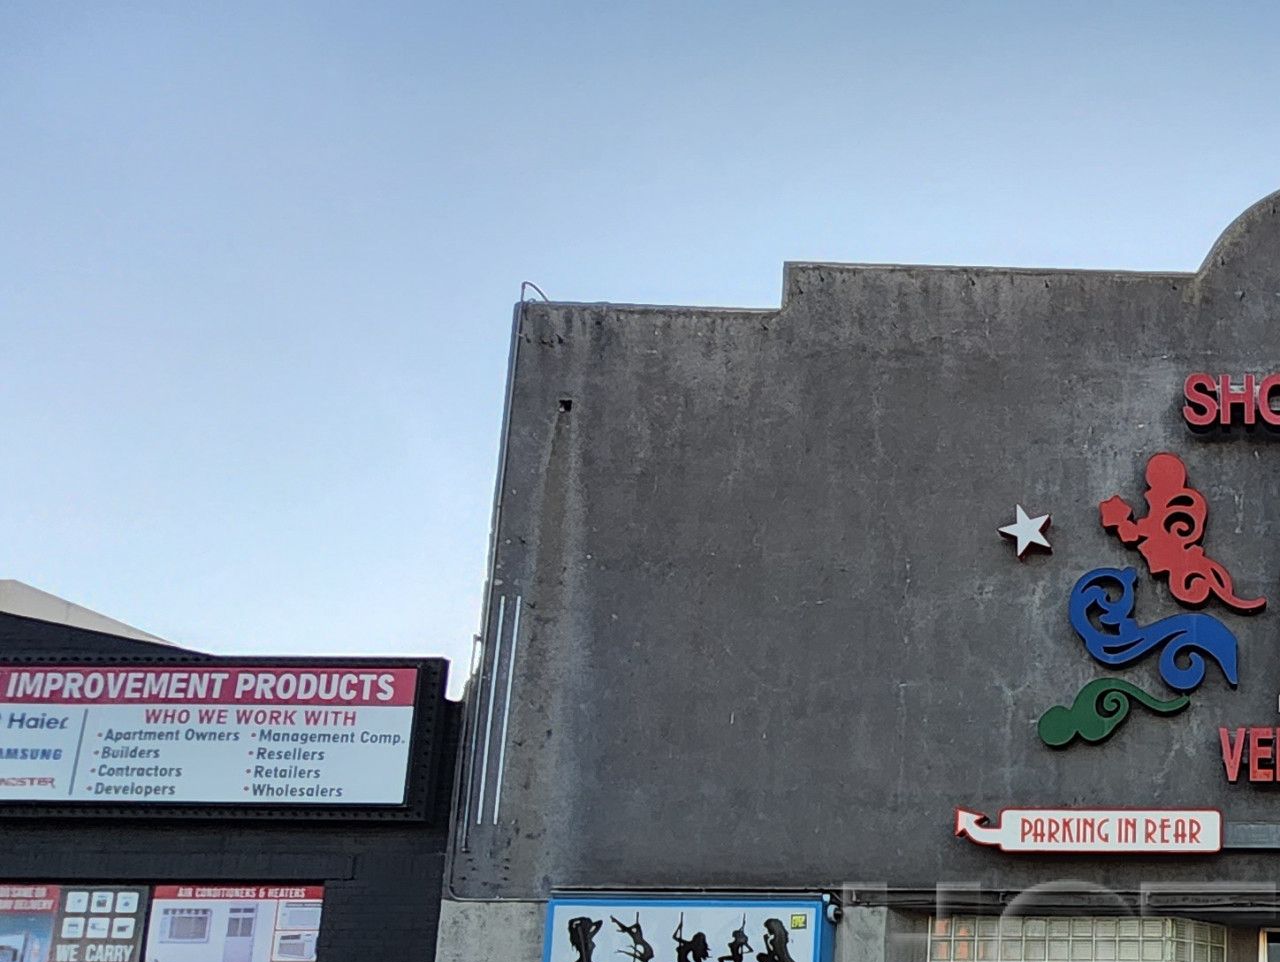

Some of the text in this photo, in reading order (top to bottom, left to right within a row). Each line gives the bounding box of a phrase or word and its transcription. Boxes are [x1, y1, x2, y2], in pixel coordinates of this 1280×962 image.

[6, 671, 396, 701] IMPROVEMENT PRODUCTS
[7, 711, 70, 730] Haier
[145, 708, 357, 727] WHO WE WORK WITH
[104, 728, 241, 742] Apartment Owners
[259, 729, 406, 746] Management Comp.
[101, 745, 160, 760] Builders
[256, 747, 325, 761] Resellers
[98, 763, 183, 778] Contractors
[254, 765, 321, 779] Retailers
[94, 781, 176, 797] Developers
[252, 783, 344, 798] Wholesalers
[1020, 818, 1201, 843] PARKING IN REAR
[267, 887, 306, 898] HEATERS
[56, 944, 134, 962] WE CARRY
